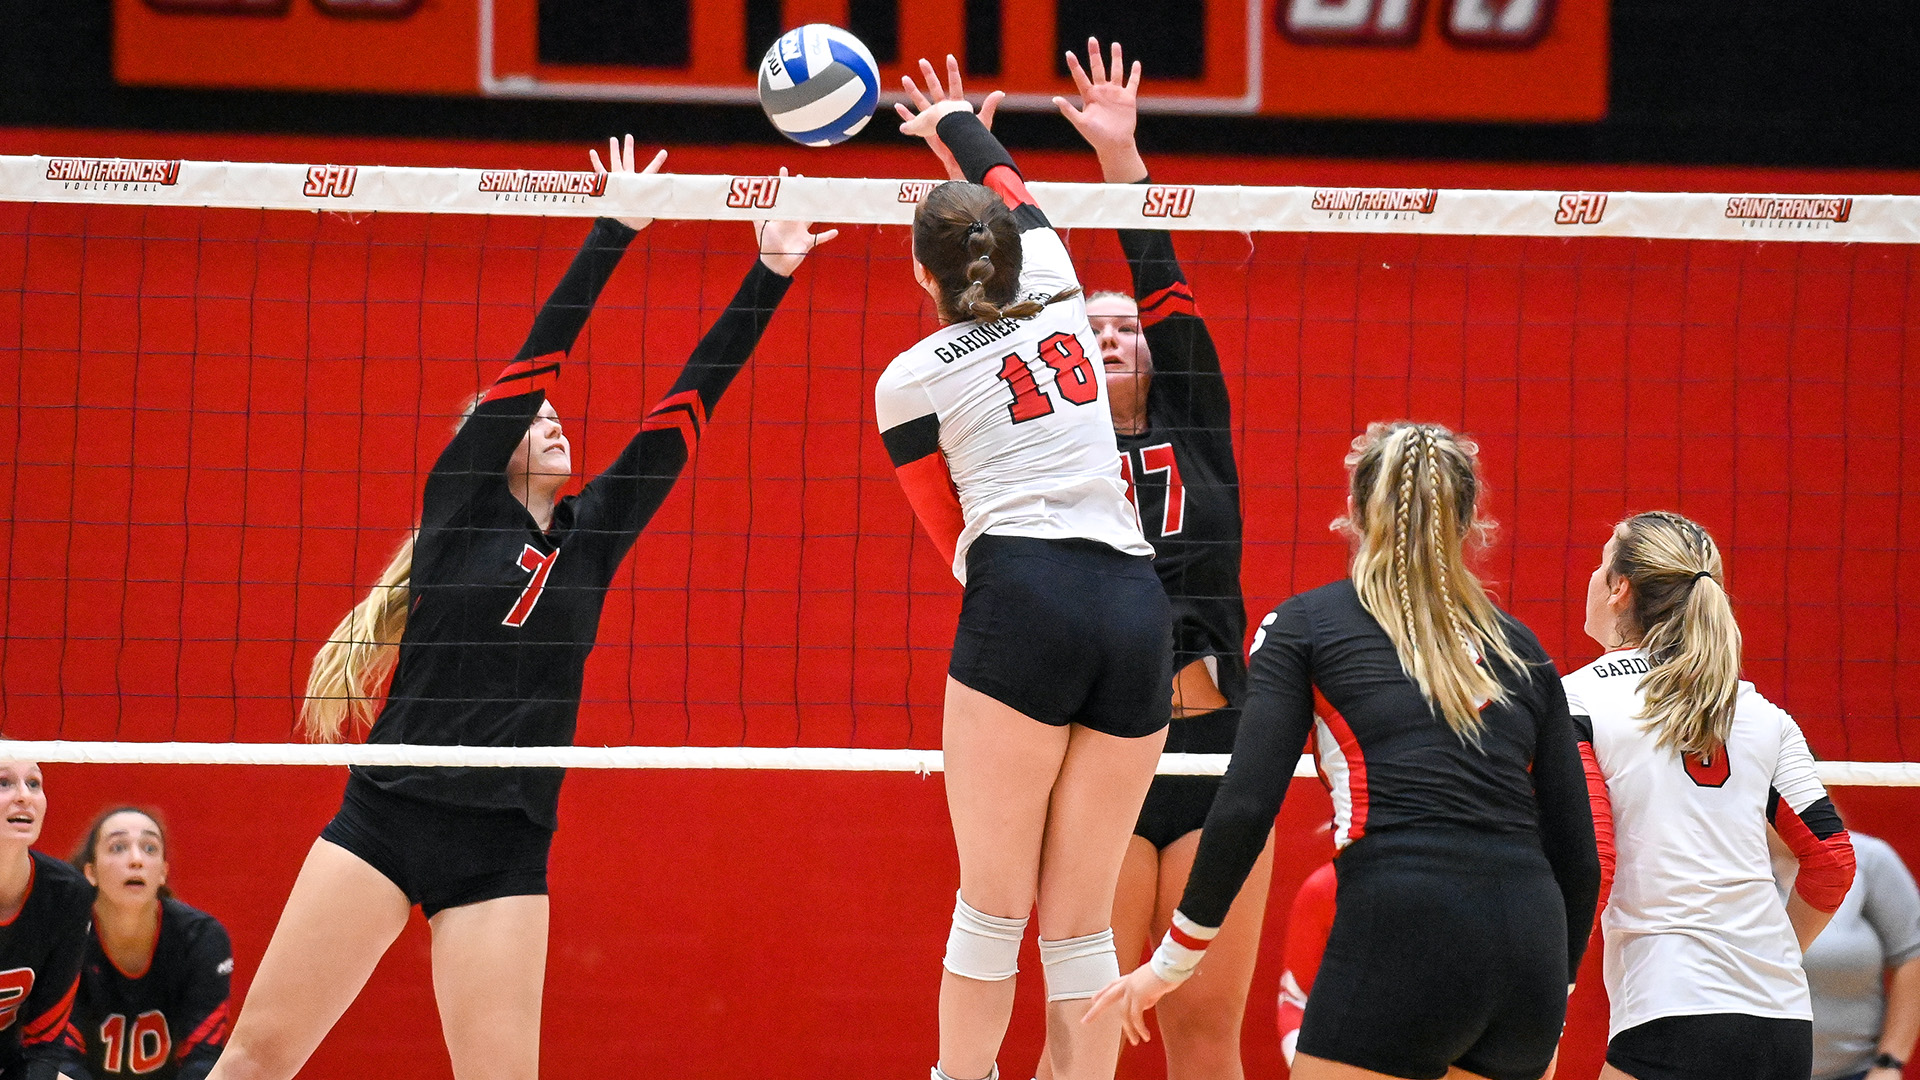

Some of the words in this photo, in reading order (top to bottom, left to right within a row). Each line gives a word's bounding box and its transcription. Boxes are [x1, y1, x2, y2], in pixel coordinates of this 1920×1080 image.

[64, 181, 158, 192] VOLLEYBALL
[303, 165, 358, 198] SFU
[726, 176, 781, 209] SFU
[495, 193, 586, 204] VOLLEYBALL
[1142, 186, 1195, 218] SFU
[1555, 193, 1608, 225] SFU
[1328, 211, 1416, 221] VOLLEYBALL
[996, 331, 1098, 425] 18
[501, 543, 561, 628] 7
[101, 1009, 172, 1075] 10
